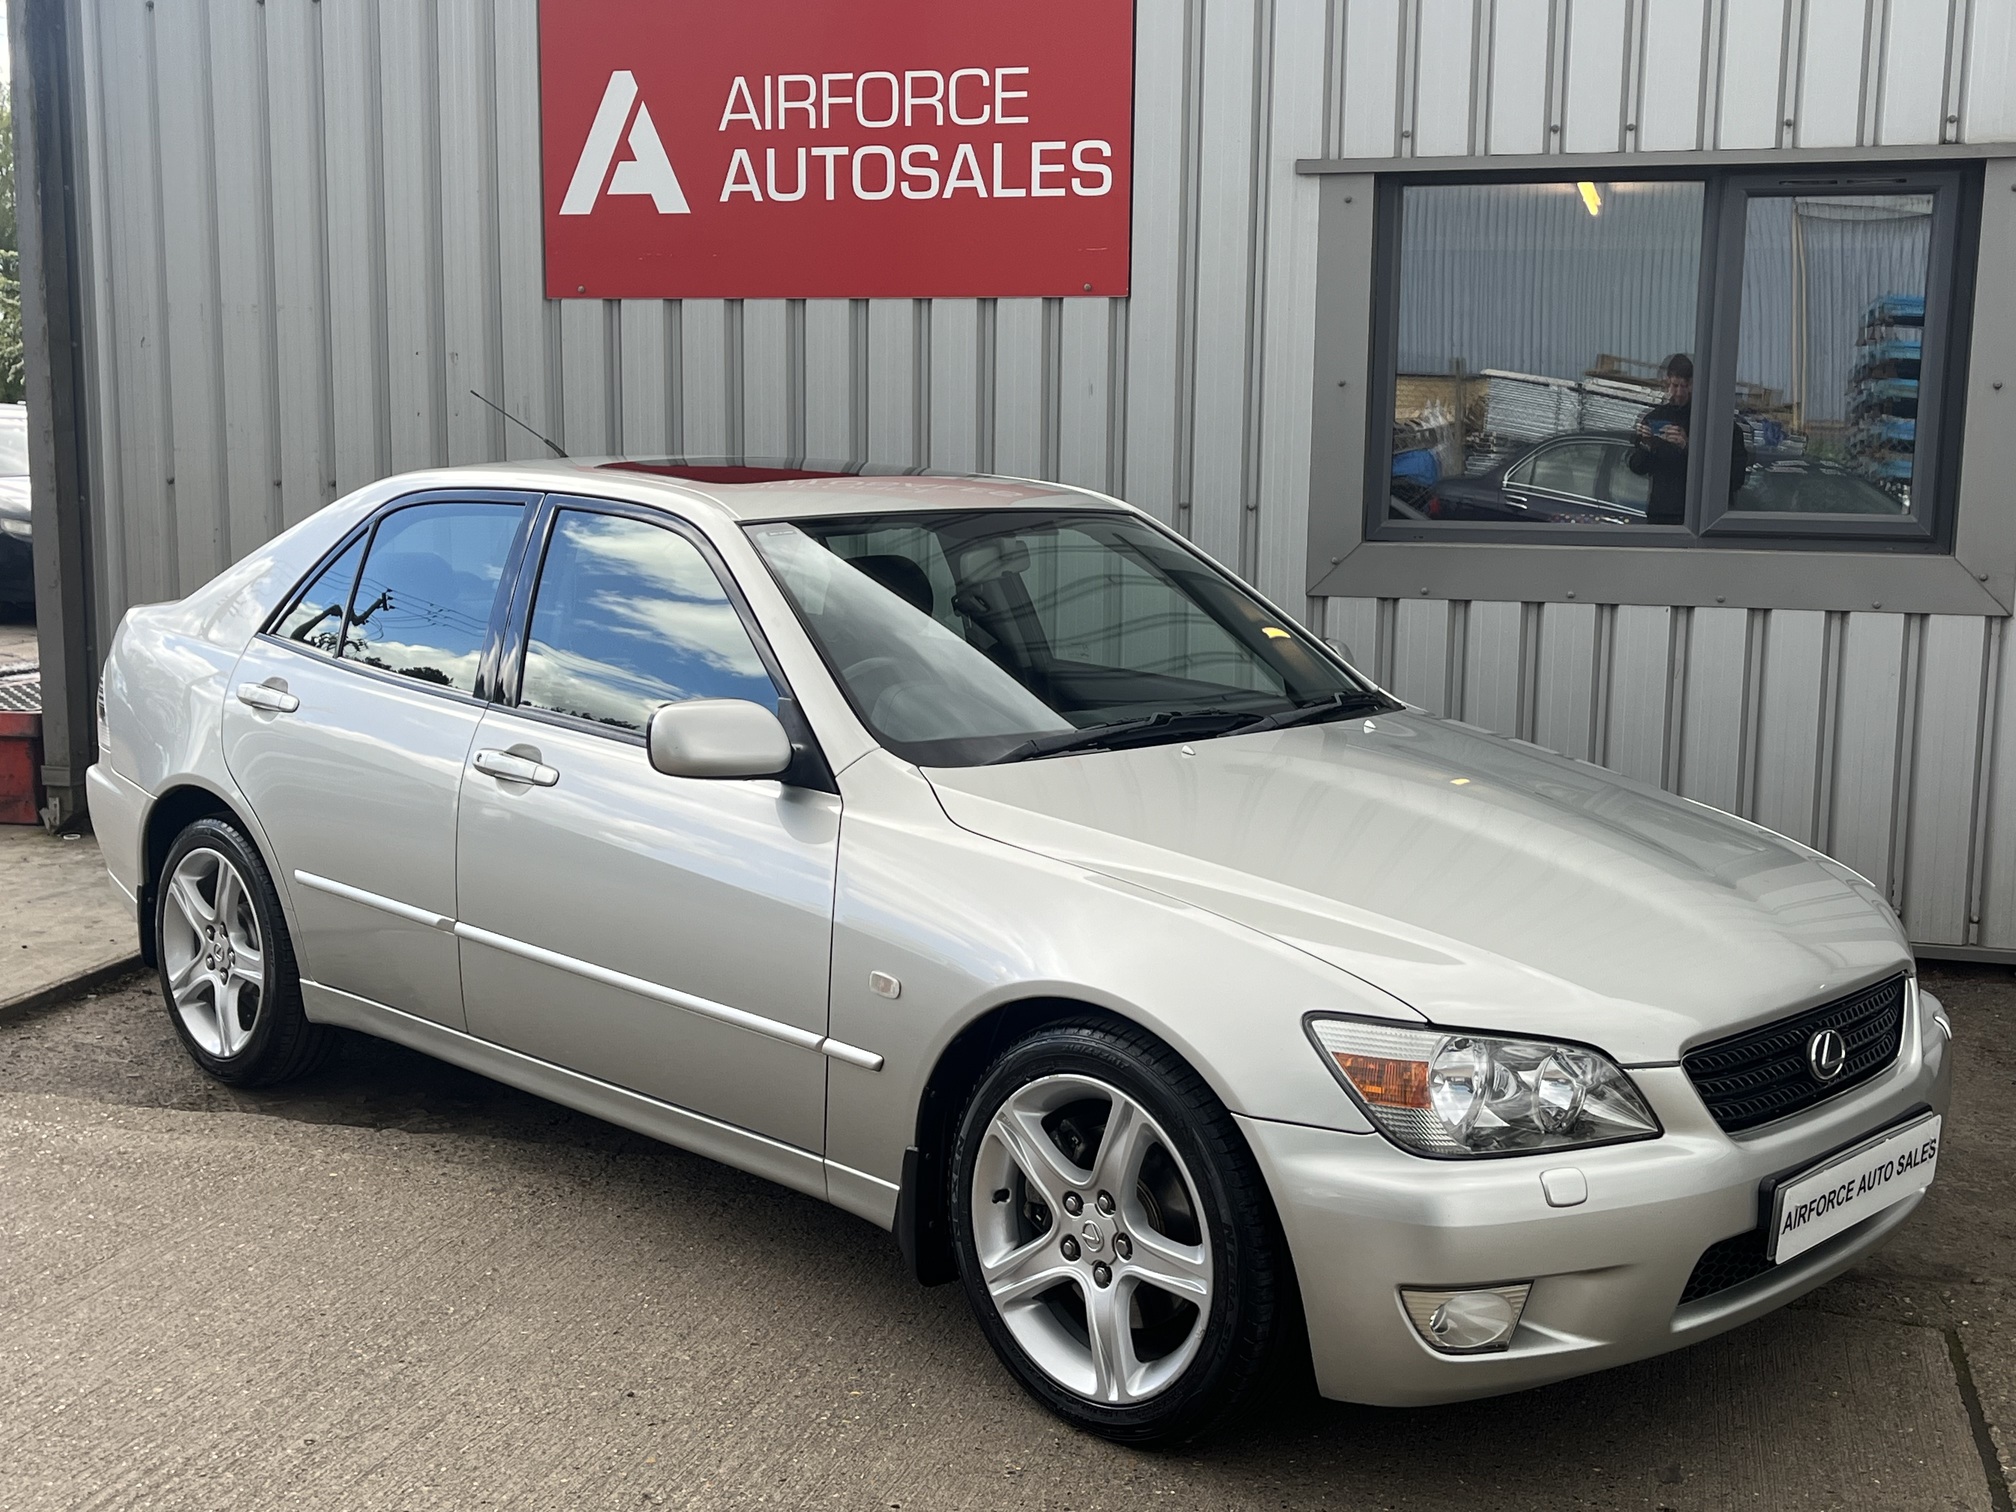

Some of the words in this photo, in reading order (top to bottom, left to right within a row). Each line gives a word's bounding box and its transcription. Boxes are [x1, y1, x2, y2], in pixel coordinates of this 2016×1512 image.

[718, 66, 1029, 132] AIRFORCE
[719, 139, 1113, 203] AUTOSALES
[1781, 1179, 1856, 1235] AIRFORCE
[1857, 1160, 1894, 1197] AUTO
[1897, 1138, 1937, 1176] SALES
